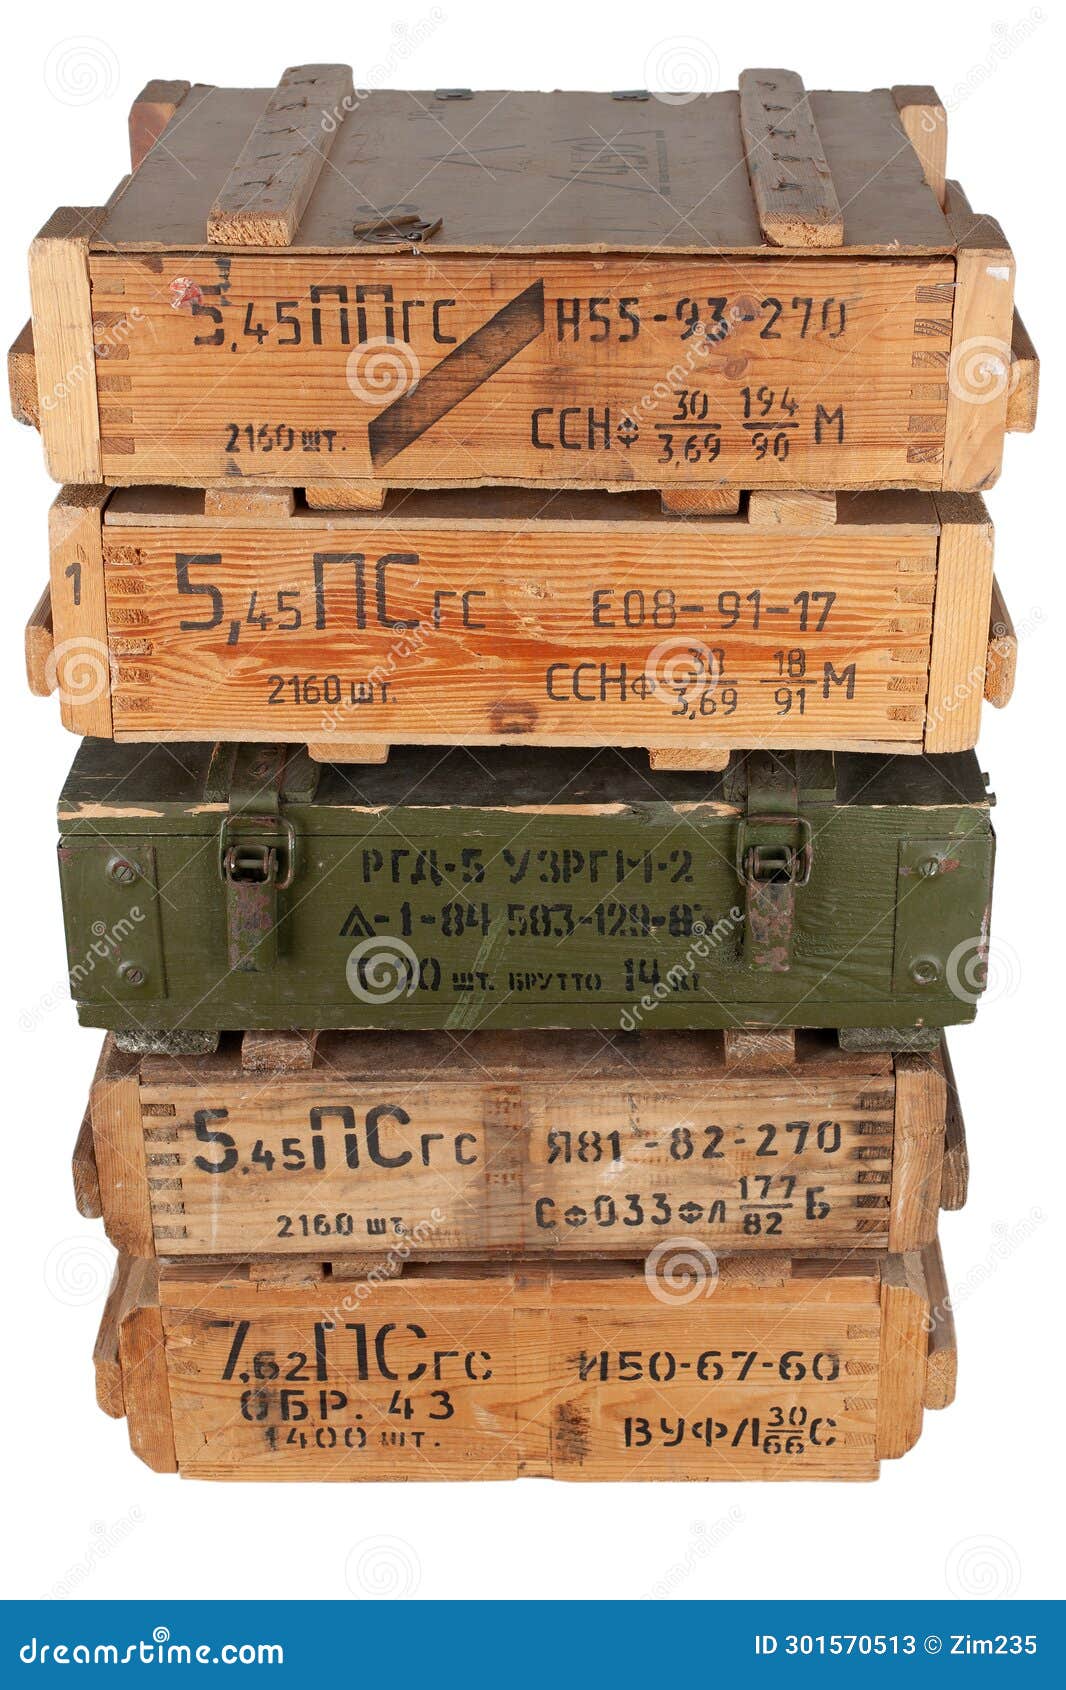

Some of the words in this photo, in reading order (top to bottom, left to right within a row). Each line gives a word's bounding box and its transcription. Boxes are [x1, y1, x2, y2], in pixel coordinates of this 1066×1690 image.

[672, 389, 709, 421] 30
[739, 384, 800, 419] 194
[813, 402, 845, 445] М
[657, 432, 723, 470] 3,69
[751, 431, 791, 462] 90
[64, 561, 82, 606] 1
[591, 588, 838, 633] Е08-91-17
[267, 673, 342, 705] 2160
[773, 648, 807, 678] 18
[822, 660, 857, 701] М
[671, 687, 739, 721] 3,69
[773, 687, 806, 717] 91
[508, 971, 603, 992] БРУТТО
[623, 957, 662, 992] 14
[737, 1174, 797, 1200] 177
[276, 1212, 354, 1239] 2160
[805, 1185, 831, 1221] Б
[742, 1212, 783, 1236] 82
[767, 1405, 808, 1428] 30
[762, 1434, 806, 1455] 66
